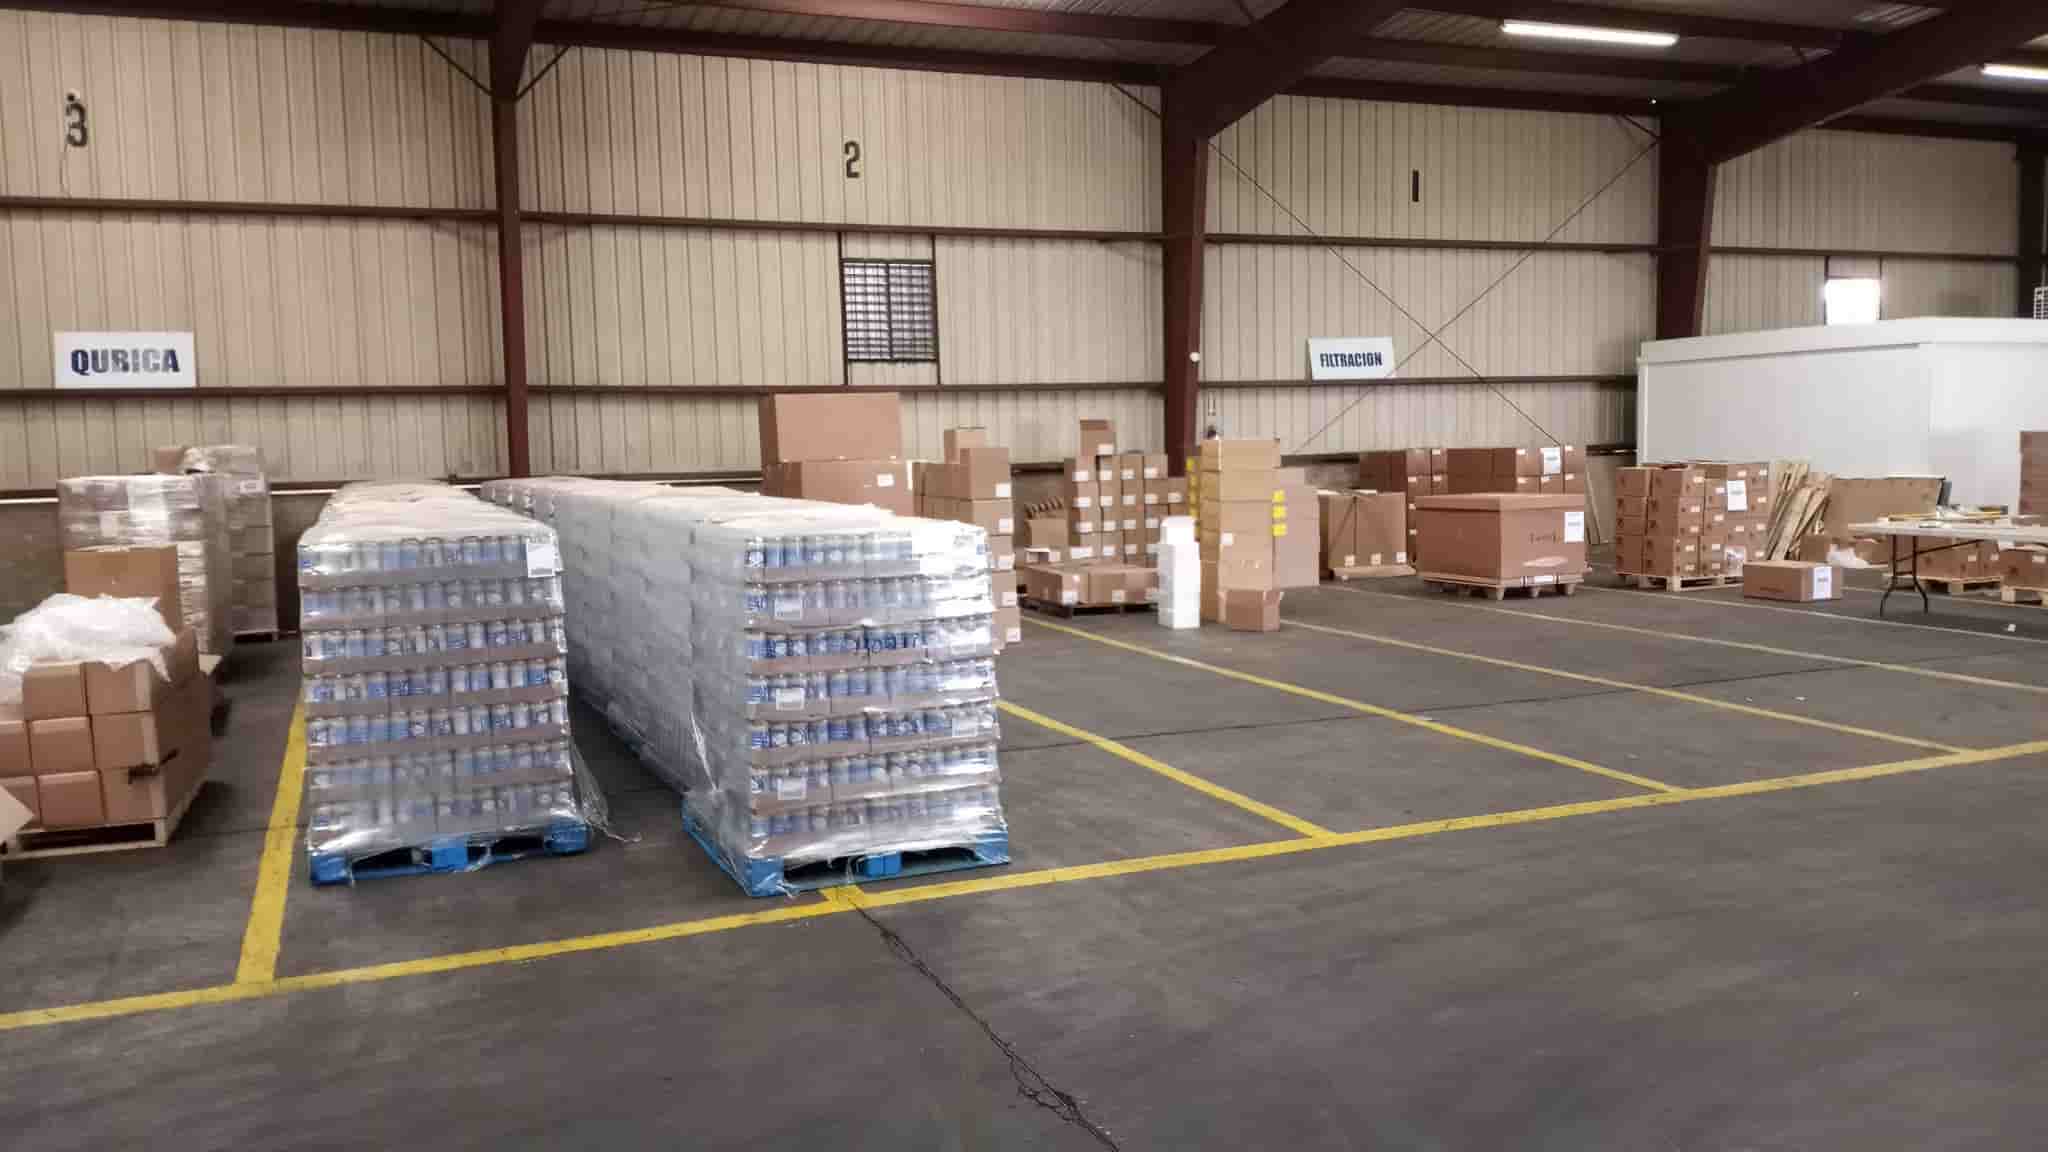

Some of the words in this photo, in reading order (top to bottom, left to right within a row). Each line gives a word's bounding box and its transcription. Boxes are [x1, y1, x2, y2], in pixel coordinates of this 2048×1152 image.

[65, 103, 87, 147] 3
[844, 140, 860, 178] 2
[1319, 351, 1383, 369] FILTRACION
